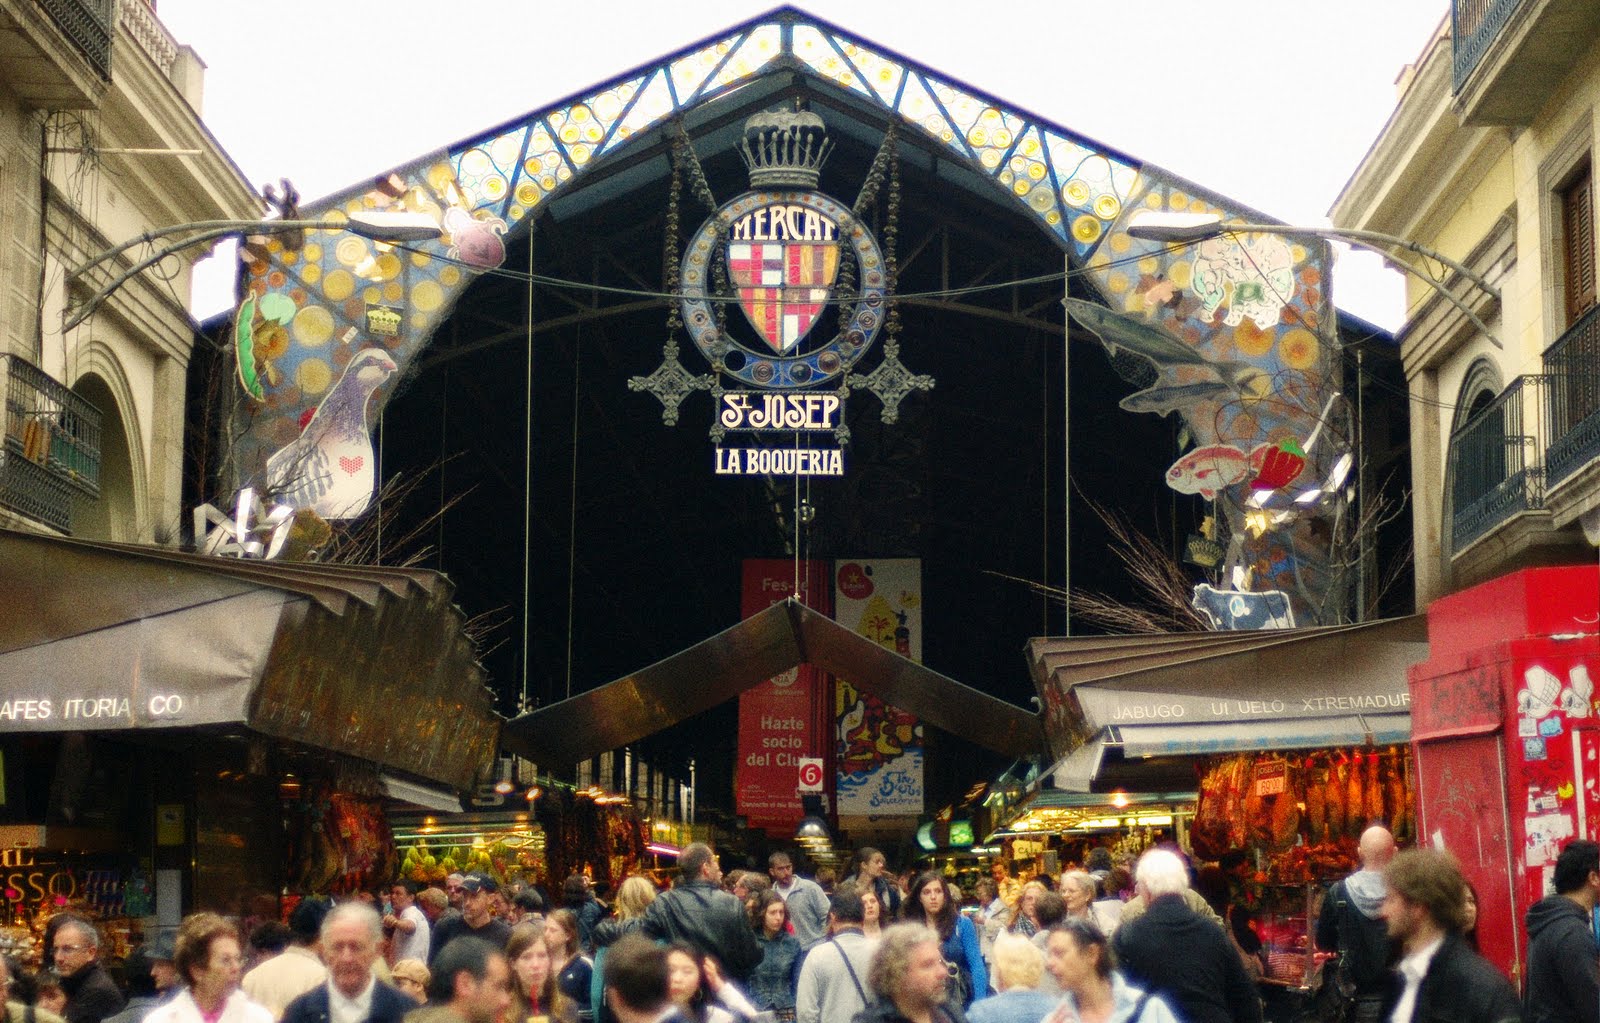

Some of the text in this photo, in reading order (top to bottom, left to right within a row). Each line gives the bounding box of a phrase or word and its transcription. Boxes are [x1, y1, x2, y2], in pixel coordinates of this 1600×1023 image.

[733, 205, 836, 240] MERCAT
[748, 394, 839, 428] JOSEP
[715, 449, 843, 475] LA BOQUERIA
[0, 695, 183, 720] AFES ITORIA CO
[1113, 704, 1185, 720] JABUGO
[761, 716, 804, 731] Hazte
[762, 735, 802, 748] socio
[746, 752, 807, 767] del Clu
[804, 766, 817, 783] 6
[0, 872, 76, 903] SSO
